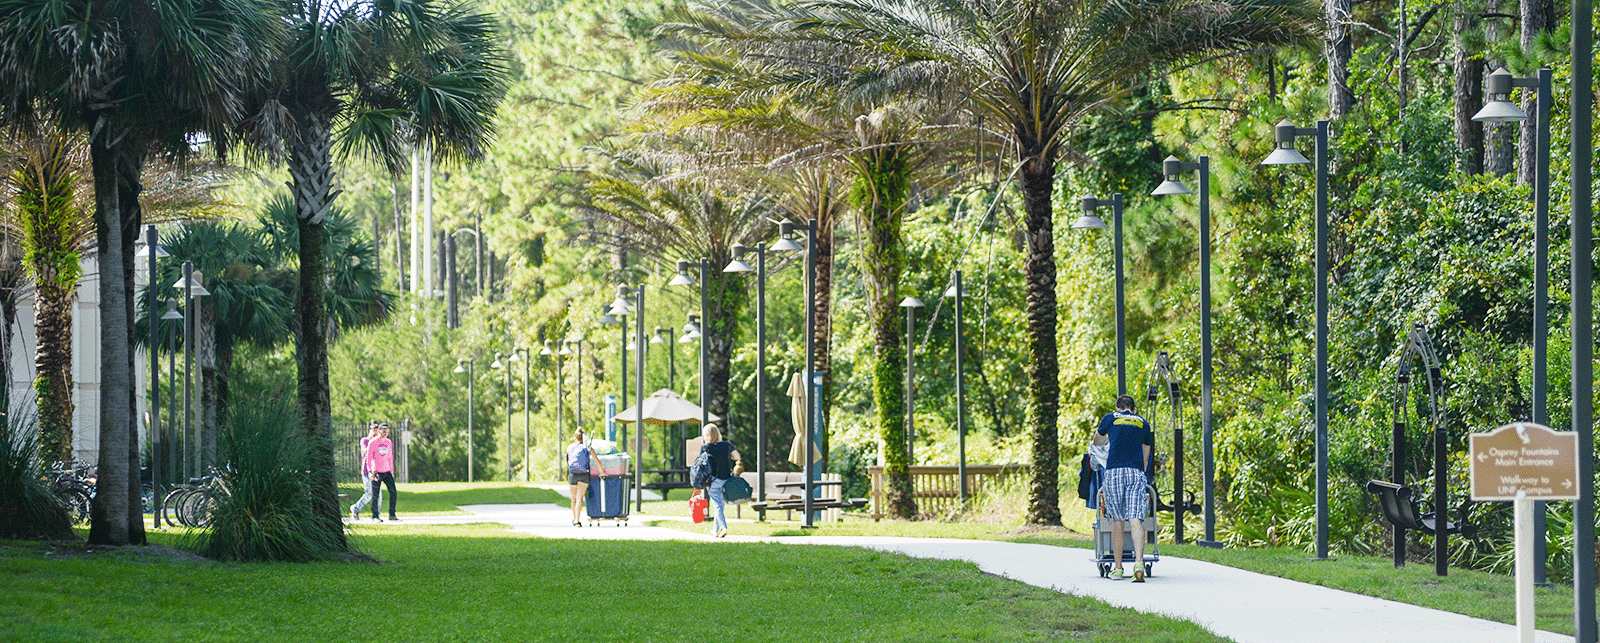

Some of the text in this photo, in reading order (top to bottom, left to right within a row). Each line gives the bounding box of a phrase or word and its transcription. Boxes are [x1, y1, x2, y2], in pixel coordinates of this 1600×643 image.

[1489, 447, 1559, 458] Osprey Fountains
[1495, 457, 1554, 466] Main Entrance
[1500, 475, 1538, 485] Walkway
[1498, 486, 1516, 494] UNF
